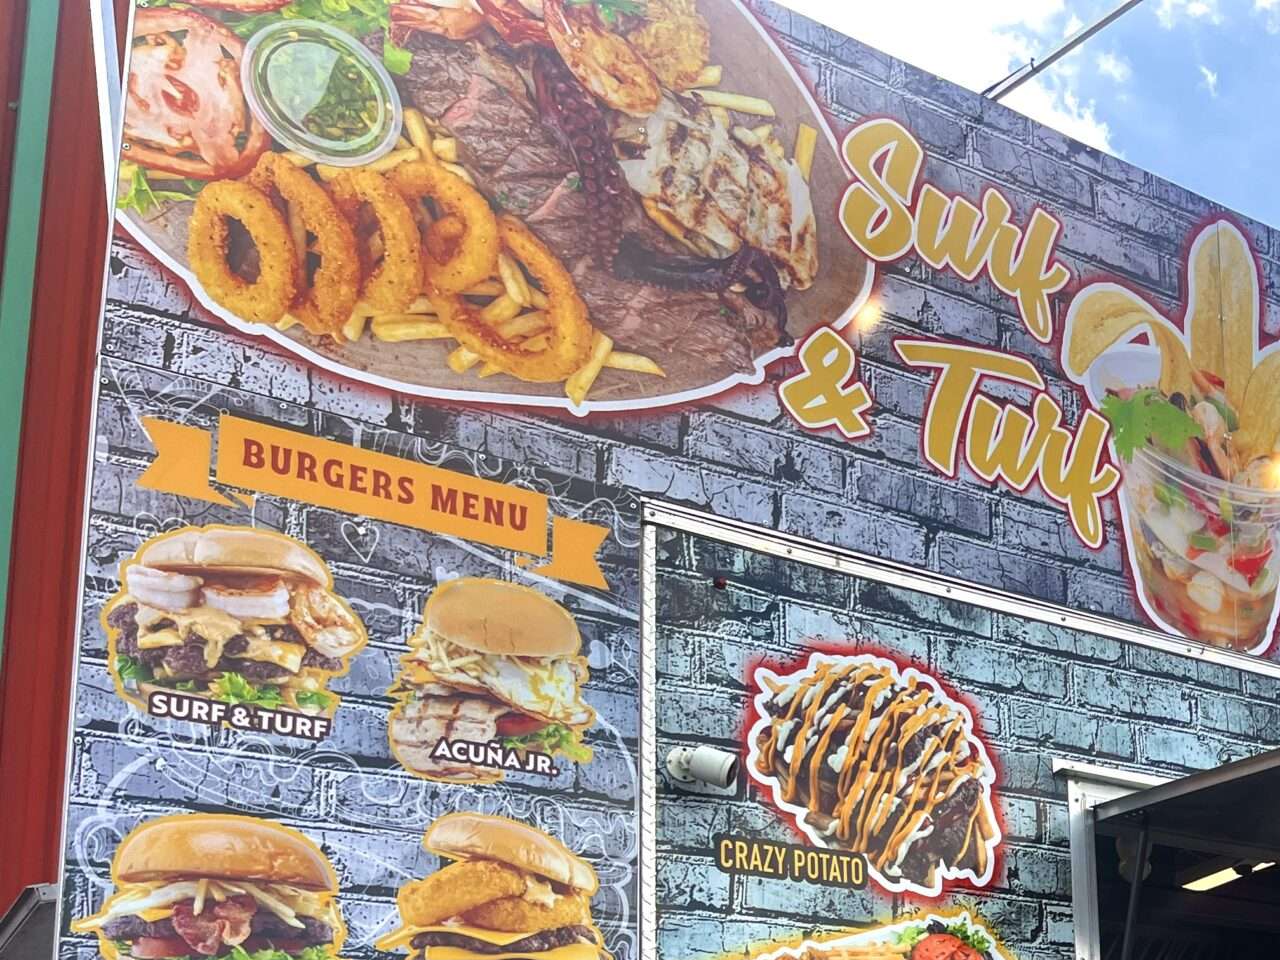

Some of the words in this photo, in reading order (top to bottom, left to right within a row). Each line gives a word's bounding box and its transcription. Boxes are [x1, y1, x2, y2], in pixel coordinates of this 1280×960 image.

[841, 117, 1069, 342] Surf
[779, 328, 871, 438] &
[894, 340, 1120, 548] Turf
[242, 437, 416, 506] BURGERS
[430, 482, 529, 533] MENU
[151, 693, 225, 725] SURF
[232, 706, 252, 731] &
[256, 710, 329, 740] TURF
[435, 734, 519, 769] ACUÑA
[521, 747, 558, 775] JR.
[720, 839, 787, 874] CRAZY
[793, 851, 864, 885] POTATO
